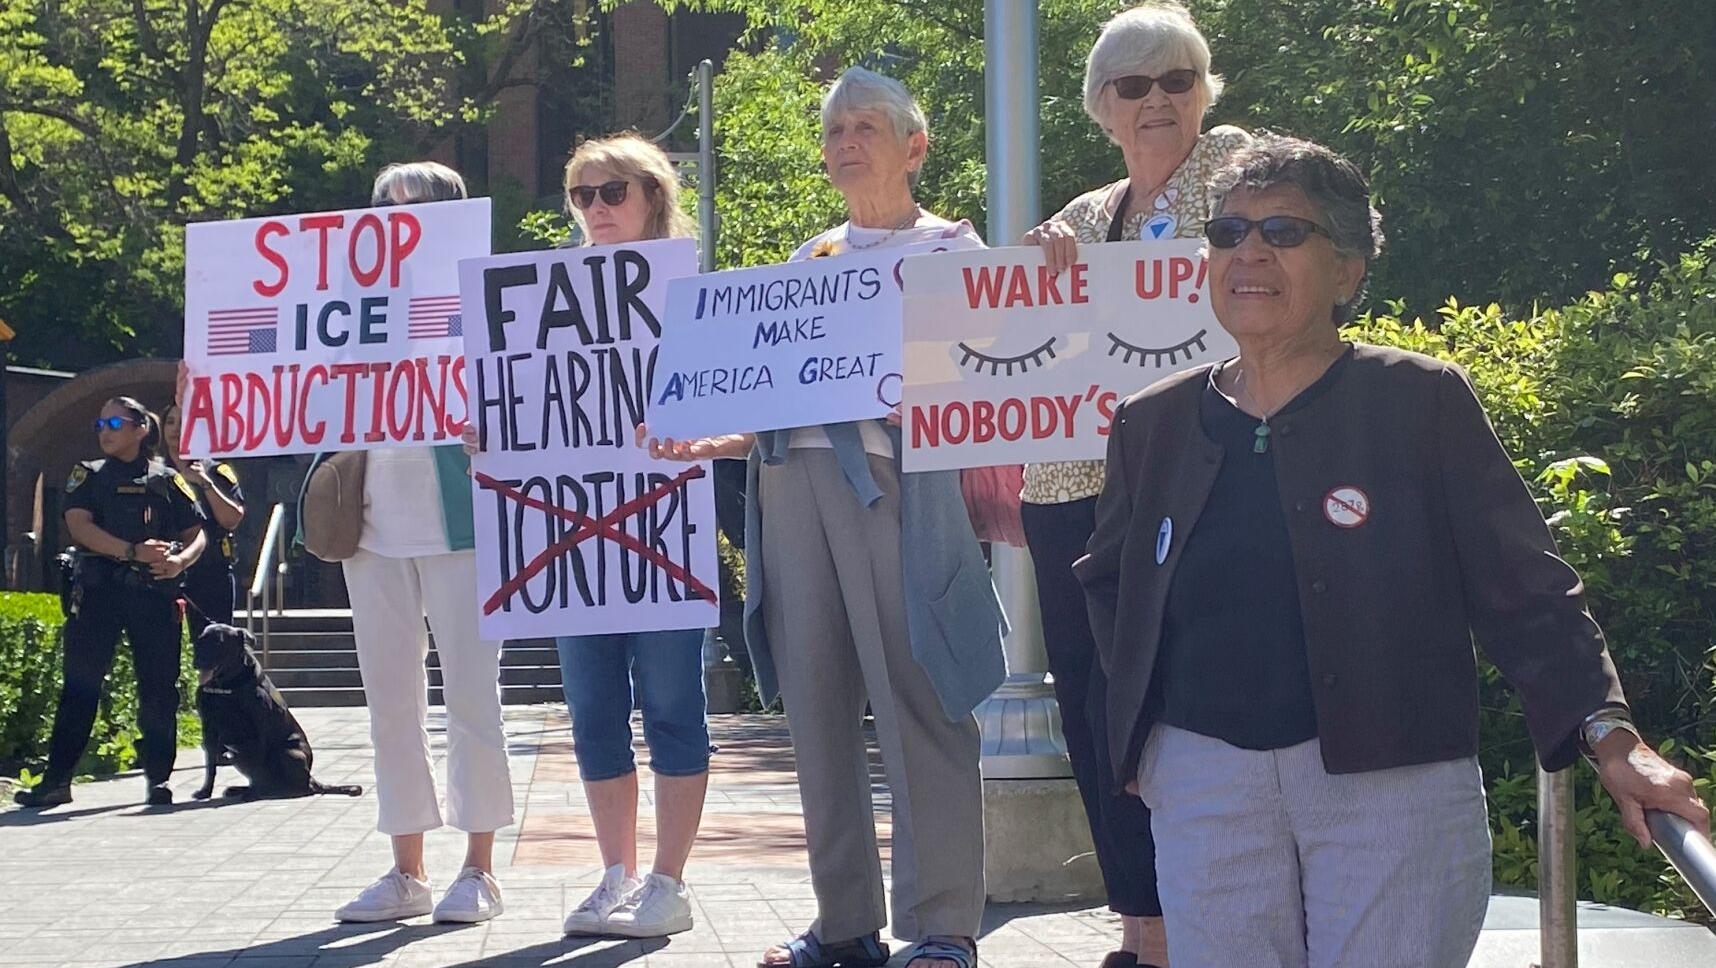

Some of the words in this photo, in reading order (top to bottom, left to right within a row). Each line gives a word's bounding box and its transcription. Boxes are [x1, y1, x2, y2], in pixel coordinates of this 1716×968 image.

[253, 212, 421, 297] STOP
[962, 263, 1089, 309] WAKE
[1136, 257, 1209, 304] UP!
[483, 250, 661, 352] FAIR
[695, 267, 881, 319] IMMIGRANTS
[295, 296, 389, 351] ICE
[753, 316, 827, 349] MAKE
[179, 355, 469, 455] ABDUCTIONS
[658, 364, 774, 405] AMERICA
[799, 353, 884, 385] GREAT
[911, 384, 1117, 449] NOBODY'S
[479, 469, 712, 614] TORTURE
